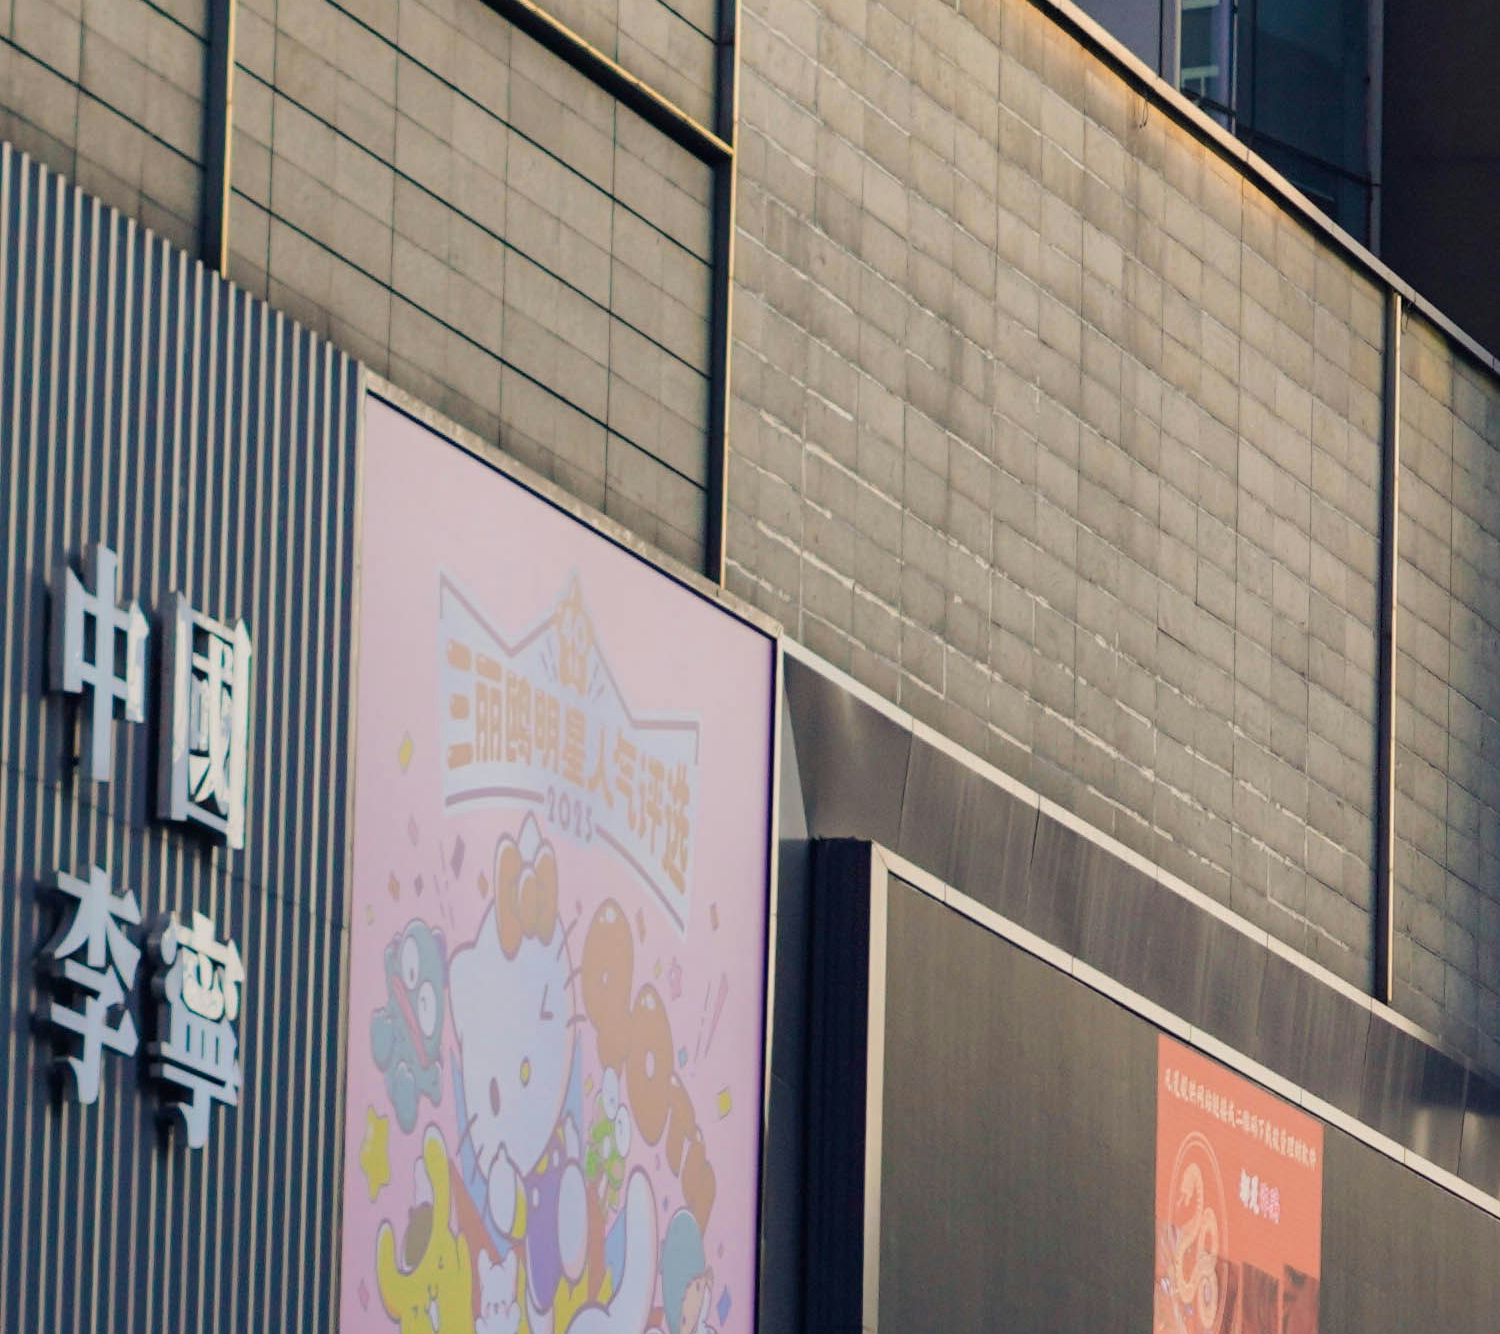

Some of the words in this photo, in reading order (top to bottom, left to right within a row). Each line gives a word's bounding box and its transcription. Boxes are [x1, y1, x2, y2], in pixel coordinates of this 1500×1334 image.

[52, 541, 252, 850] 中國
[547, 785, 593, 844] 2025
[50, 864, 244, 1150] 李寧
